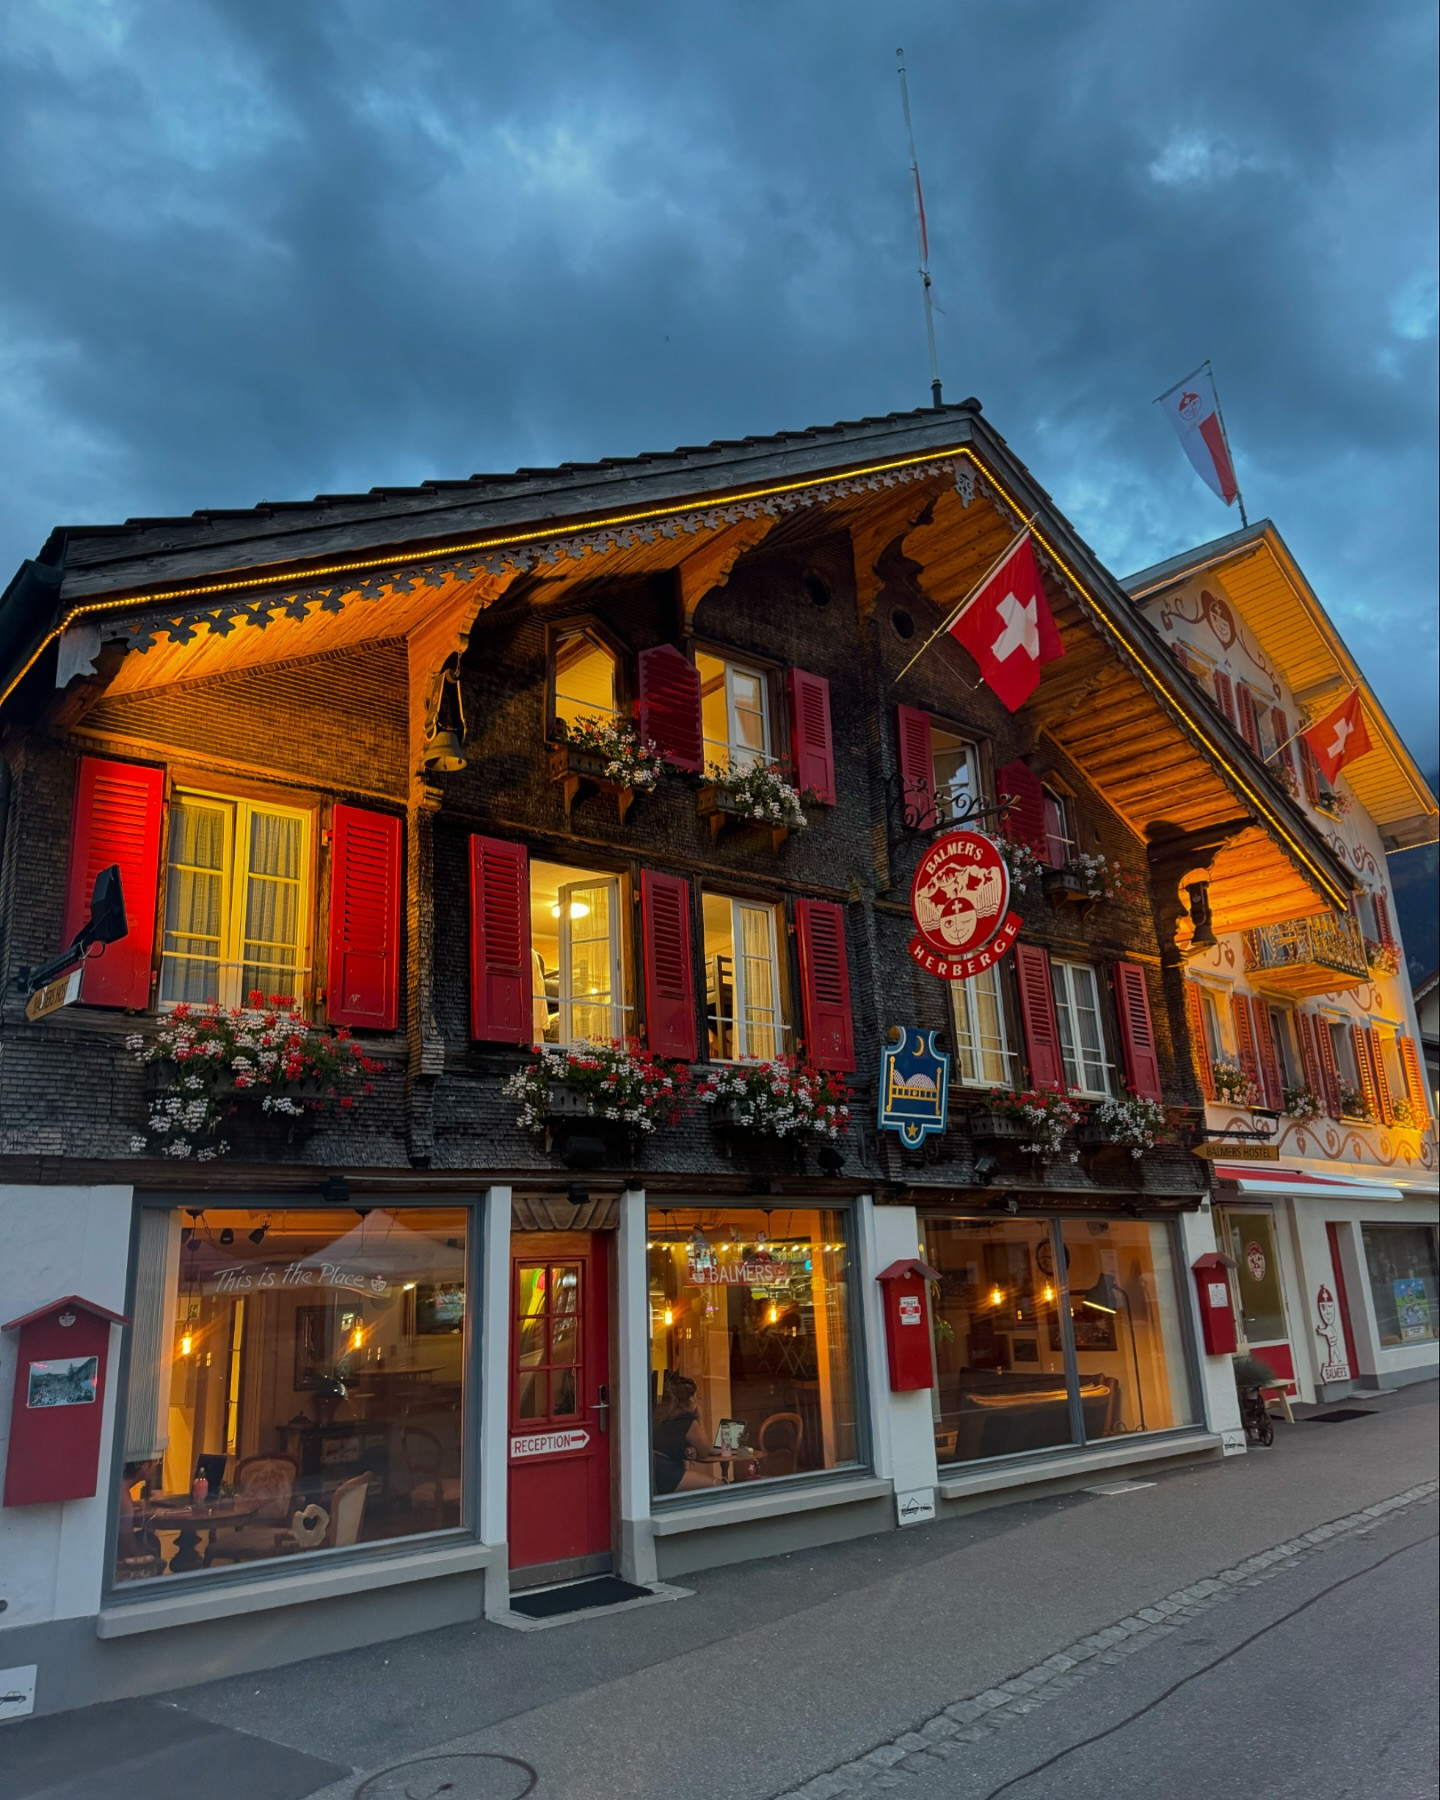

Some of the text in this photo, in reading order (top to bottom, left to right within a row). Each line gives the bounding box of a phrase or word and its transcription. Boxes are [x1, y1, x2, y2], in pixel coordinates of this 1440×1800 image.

[925, 840, 984, 875] BALMER'S
[913, 923, 1017, 976] HERBERGE
[1206, 1146, 1272, 1159] BALMERS HOSTEL
[213, 1262, 365, 1292] This is the Place
[709, 1264, 774, 1284] BALMERS
[514, 1434, 571, 1454] RECEPTION
